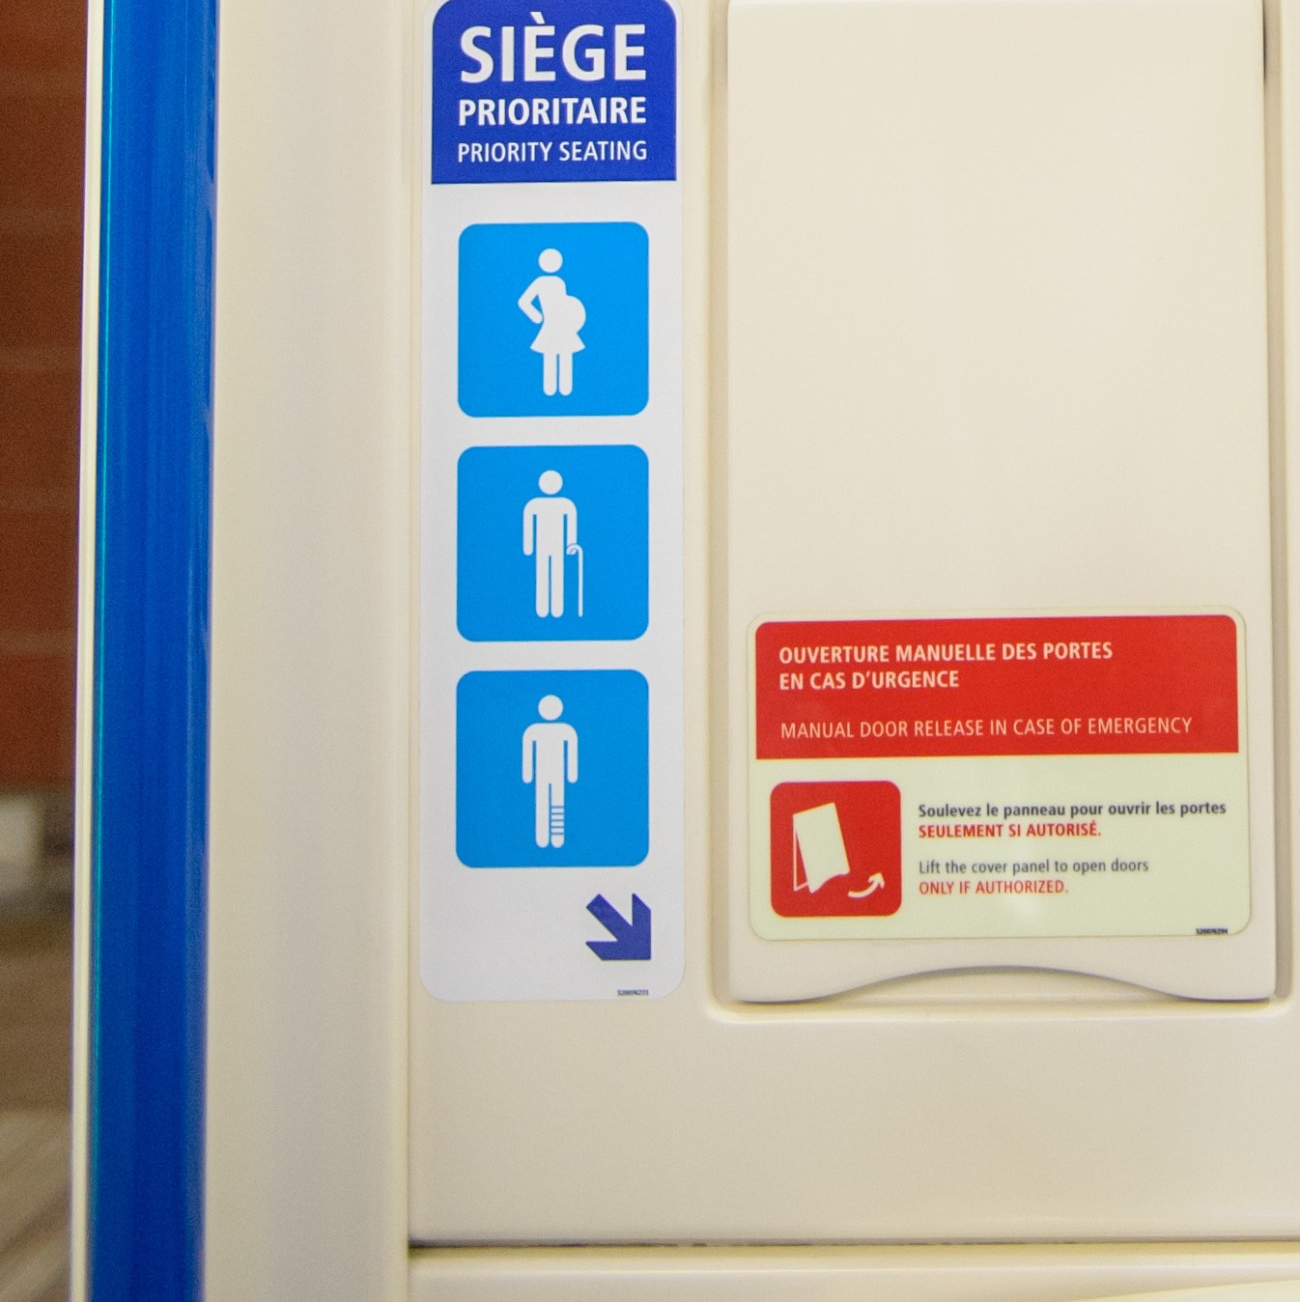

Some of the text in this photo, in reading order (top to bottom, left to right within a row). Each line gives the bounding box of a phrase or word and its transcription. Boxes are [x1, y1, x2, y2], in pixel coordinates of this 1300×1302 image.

[460, 11, 646, 83] SIÈGE
[458, 97, 646, 126] PRIORITAIRE
[458, 140, 647, 163] PRIORITY SEATING
[779, 641, 1113, 664] OUVERTURE MANUELLE DES PORTES
[779, 670, 959, 690] EN CAS D'URGENCE
[781, 717, 1192, 739] MANUAL DOOR RELEASE IN CASE OF EMERGENCY
[918, 801, 1226, 820] Soulevez le panneau pour ouvrir les portes
[918, 820, 1102, 838] SEULEMENT SI AUTORISÉ.
[918, 857, 1149, 877] Lift the cover panel to open doors
[919, 879, 1068, 895] ONLY IF AUTHORIZED.
